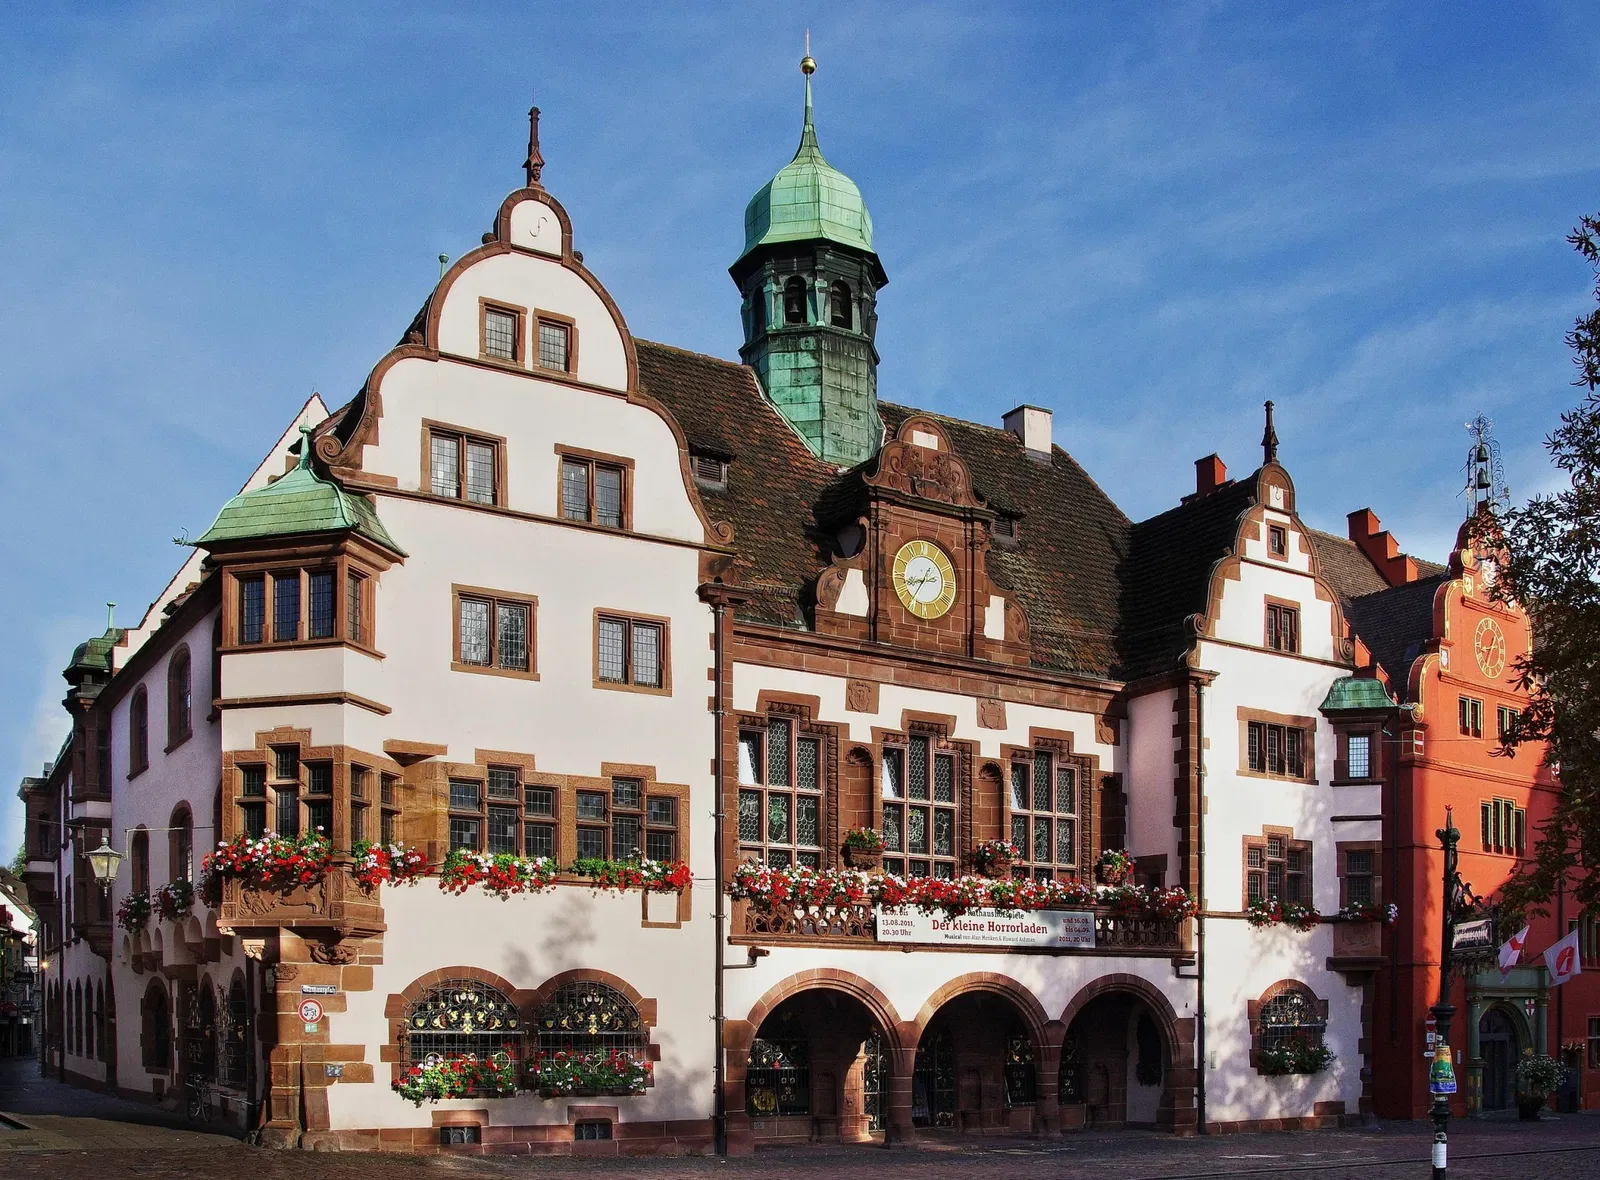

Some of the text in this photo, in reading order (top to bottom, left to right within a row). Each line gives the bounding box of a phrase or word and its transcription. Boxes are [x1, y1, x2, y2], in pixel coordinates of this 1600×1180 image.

[881, 919, 915, 927] 13.08.2011,
[932, 919, 1048, 934] Der kleine Horrorladen
